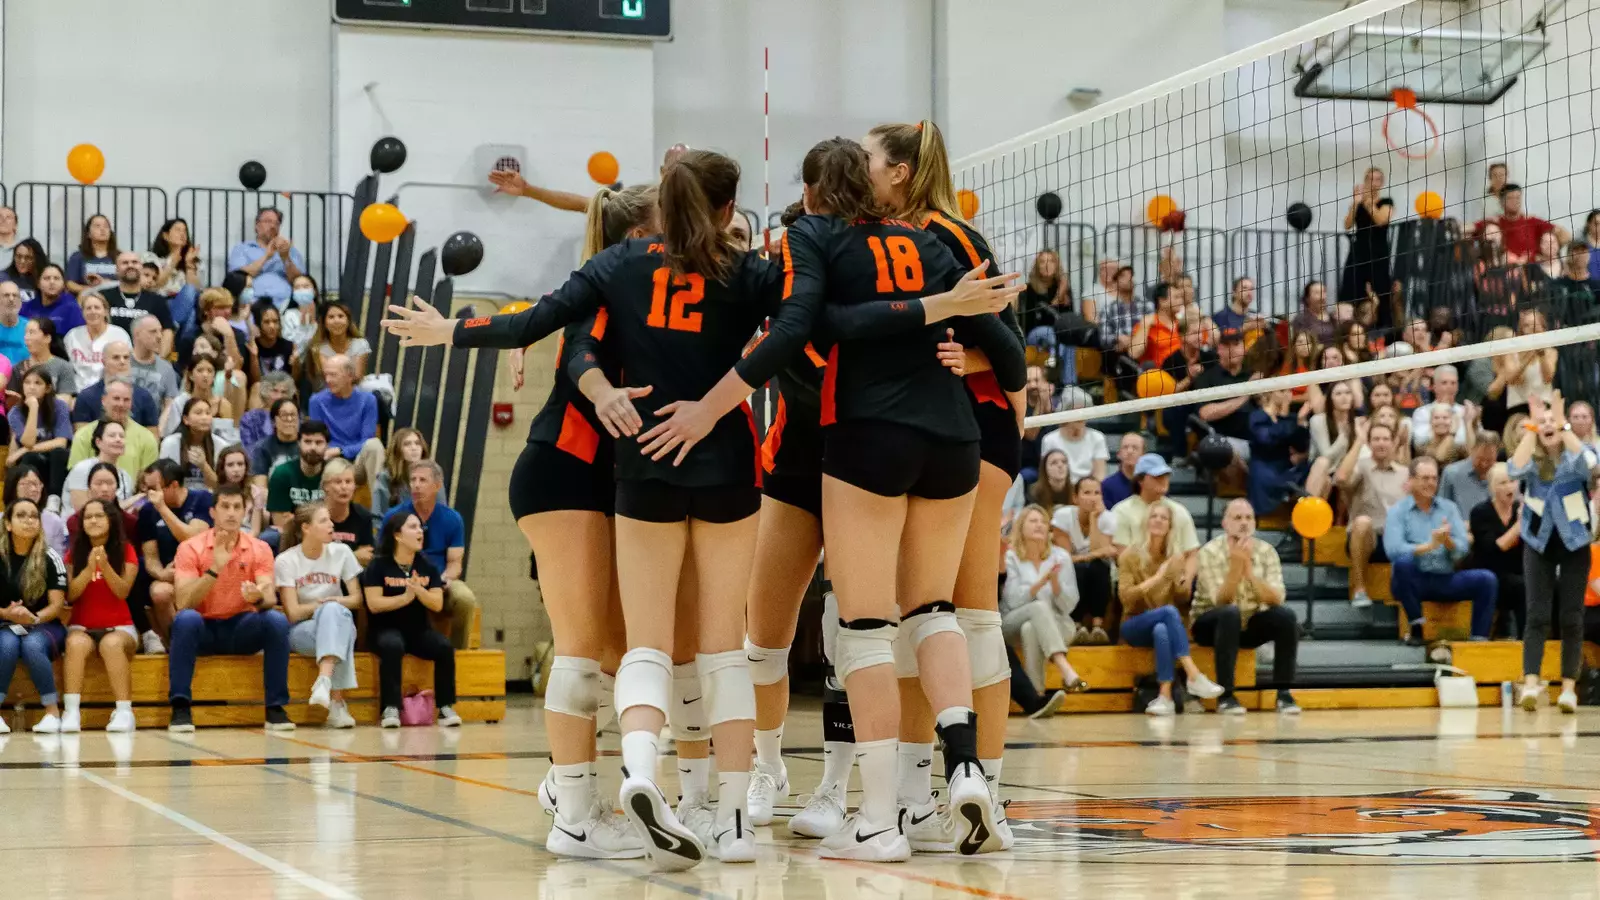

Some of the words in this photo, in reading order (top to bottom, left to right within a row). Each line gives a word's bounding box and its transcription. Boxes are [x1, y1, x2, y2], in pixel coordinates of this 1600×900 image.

[867, 235, 925, 293] 18
[647, 267, 705, 333] 12
[295, 572, 338, 588] PRNCETON
